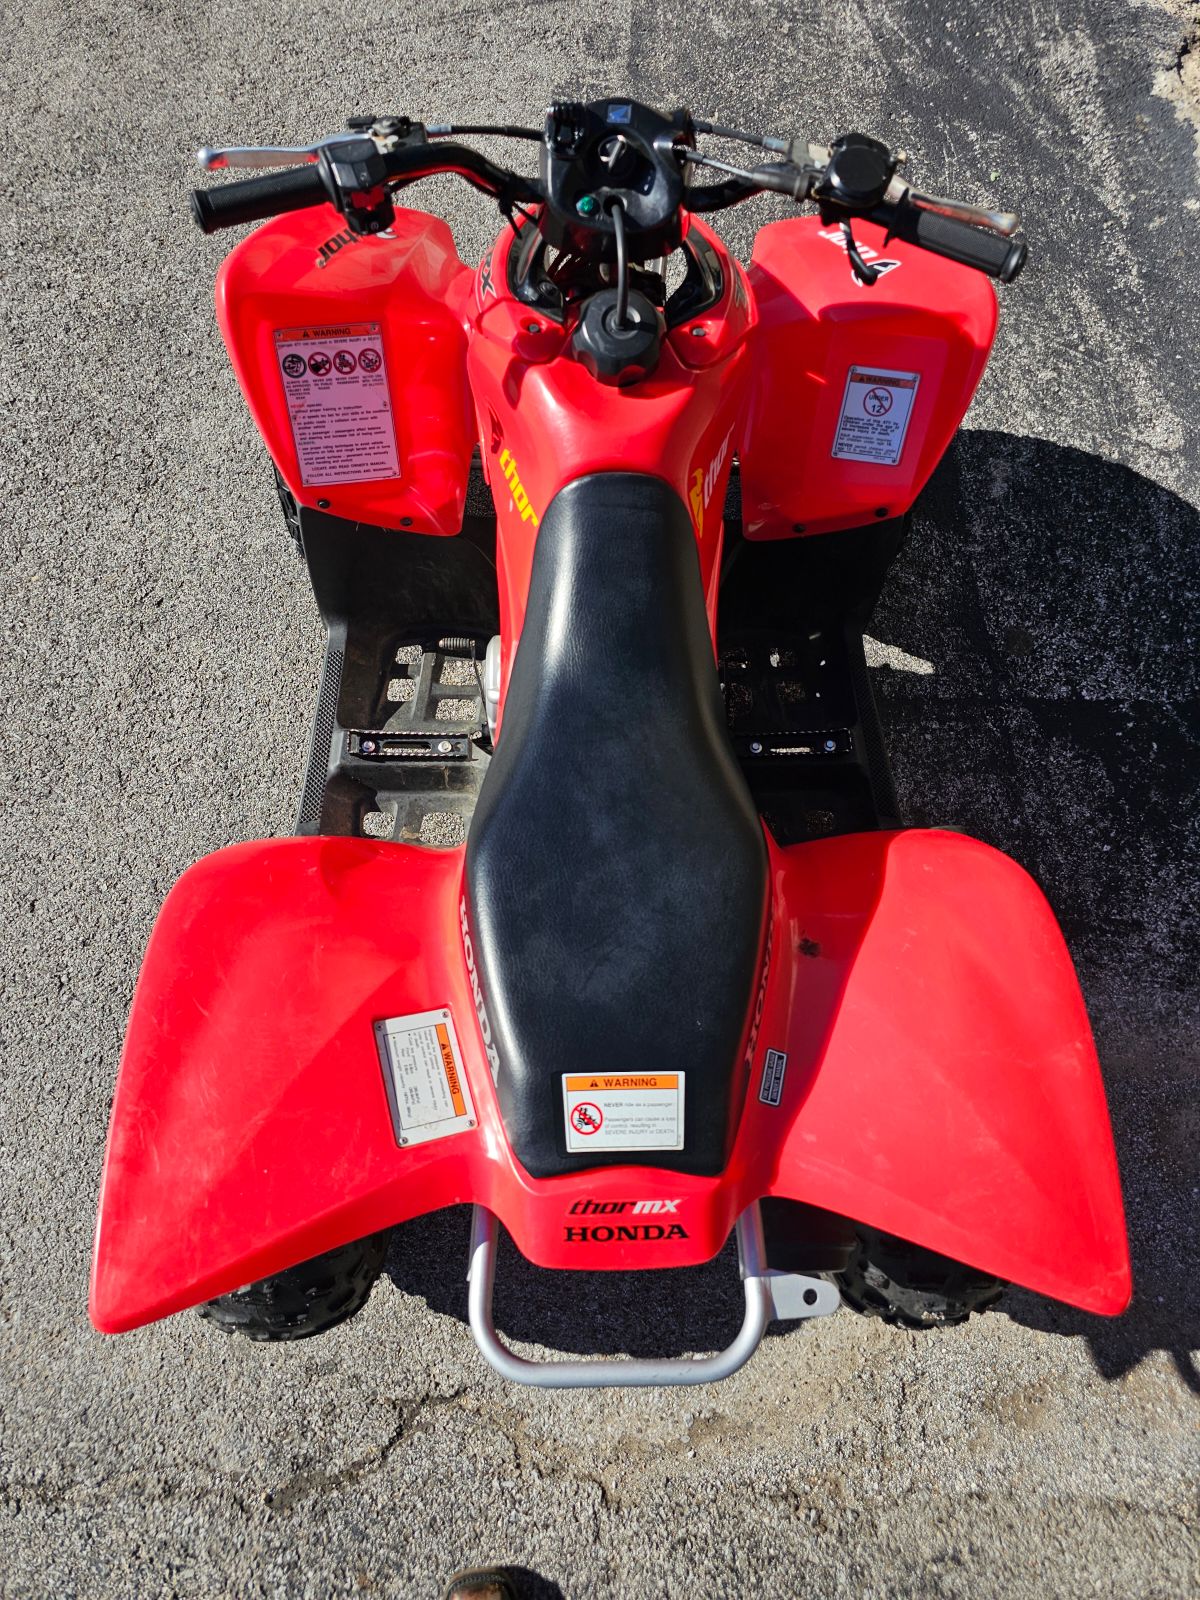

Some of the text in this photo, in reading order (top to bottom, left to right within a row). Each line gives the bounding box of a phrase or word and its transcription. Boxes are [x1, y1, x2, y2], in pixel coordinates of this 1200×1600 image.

[316, 228, 361, 269] hor
[312, 328, 352, 337] WARNING
[871, 404, 882, 413] 12
[499, 448, 539, 527] thor
[459, 895, 501, 1088] HONDA
[443, 1052, 460, 1095] WARNING
[603, 1078, 657, 1088] WARNING
[563, 1223, 690, 1242] HONDA
